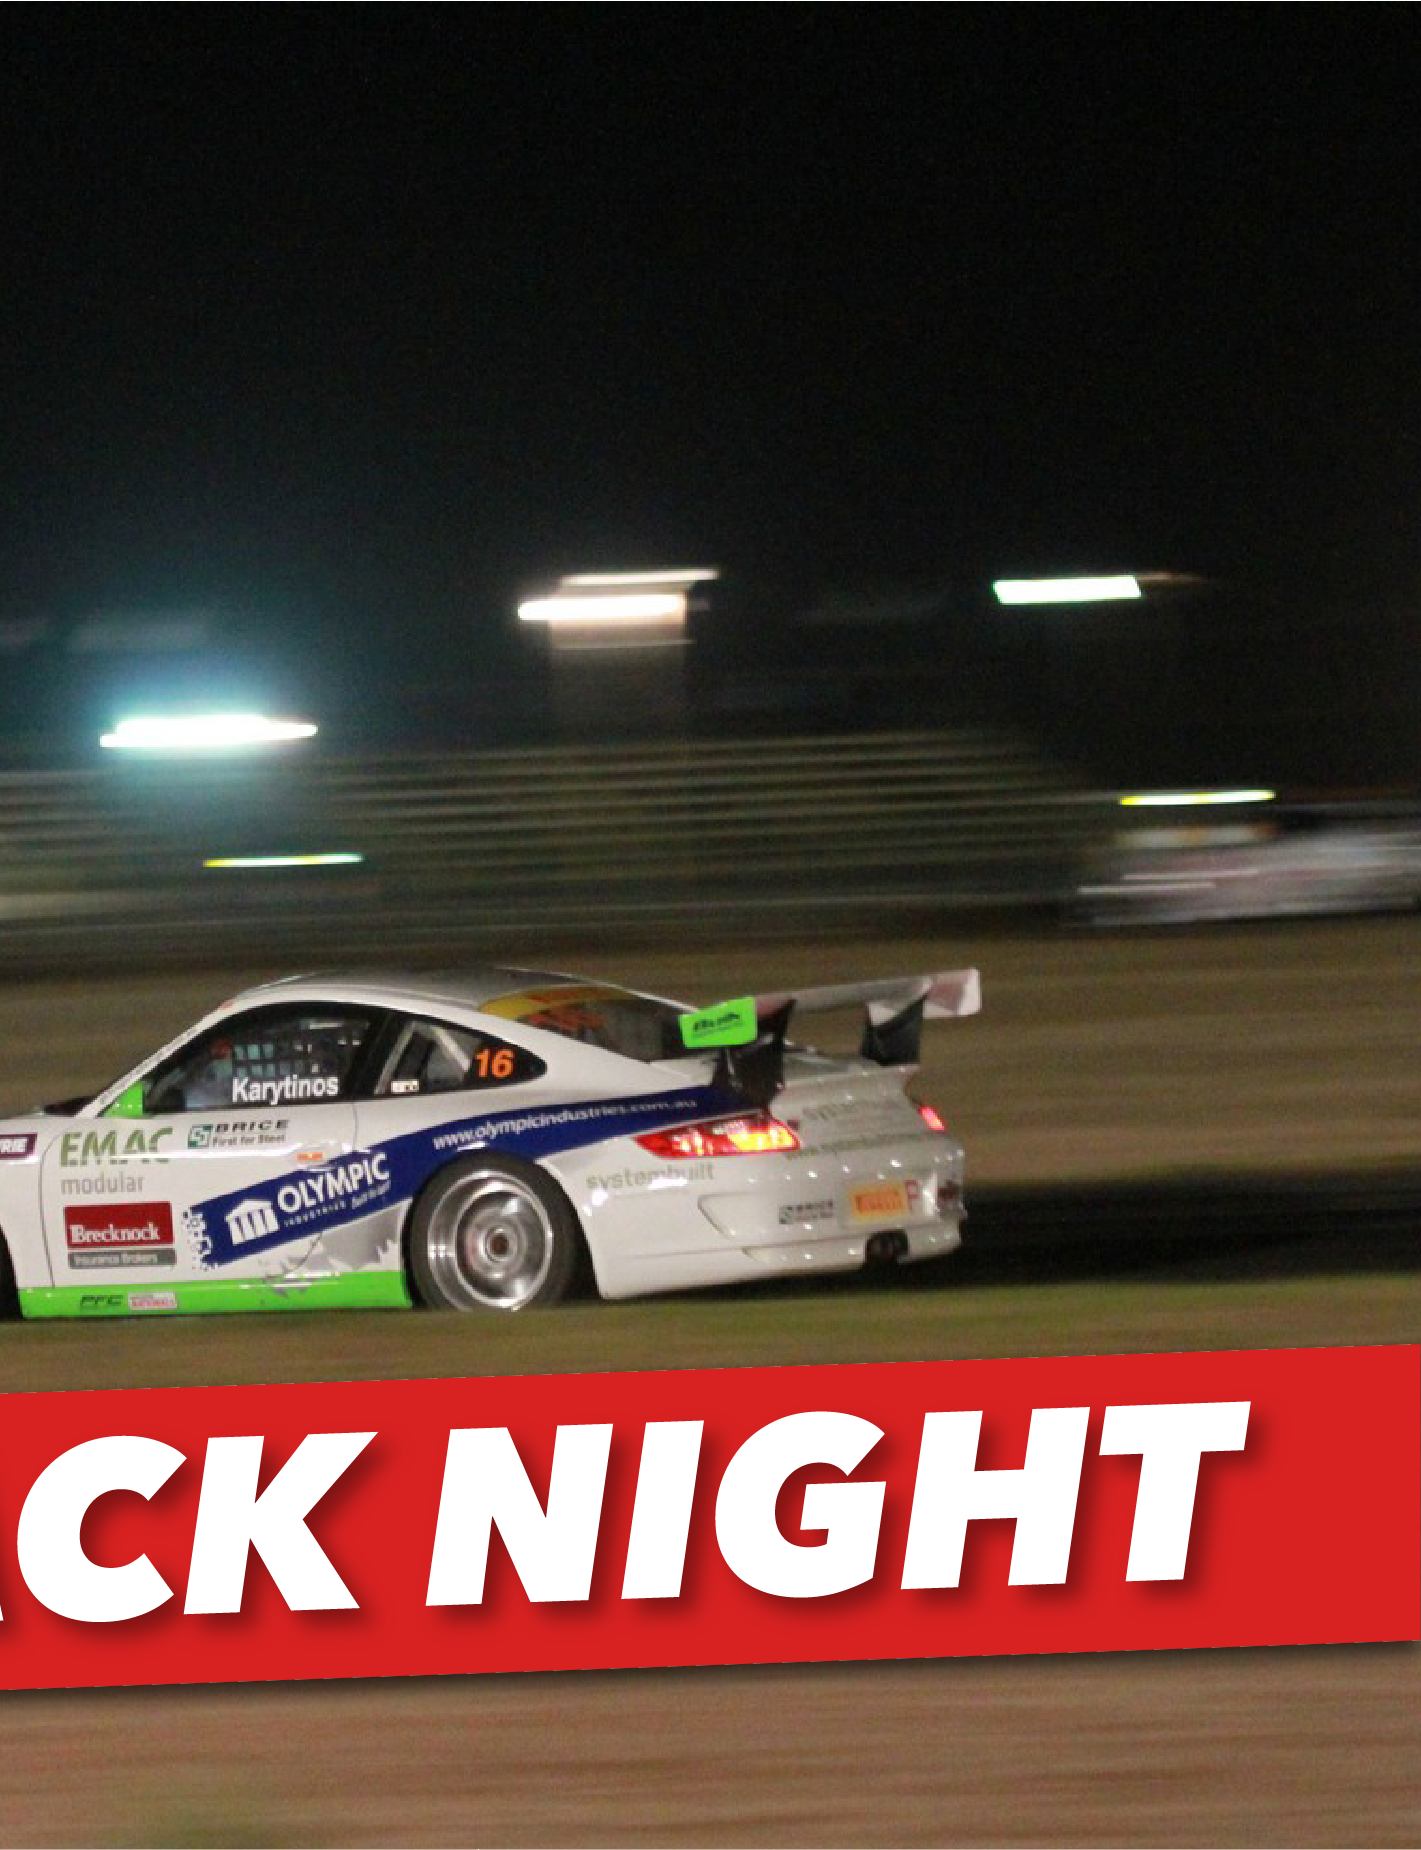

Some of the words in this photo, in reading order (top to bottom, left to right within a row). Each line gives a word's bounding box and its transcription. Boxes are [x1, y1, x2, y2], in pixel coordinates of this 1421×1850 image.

[475, 1048, 514, 1078] 16
[232, 1074, 340, 1105] Karytinos
[215, 1119, 290, 1133] BRICE
[433, 1099, 697, 1150] www.olympicindustries.com.au
[60, 1127, 173, 1167] EMAC
[60, 1171, 144, 1195] modular
[278, 1152, 391, 1213] OLYMPIC
[70, 1222, 161, 1244] Brecknock
